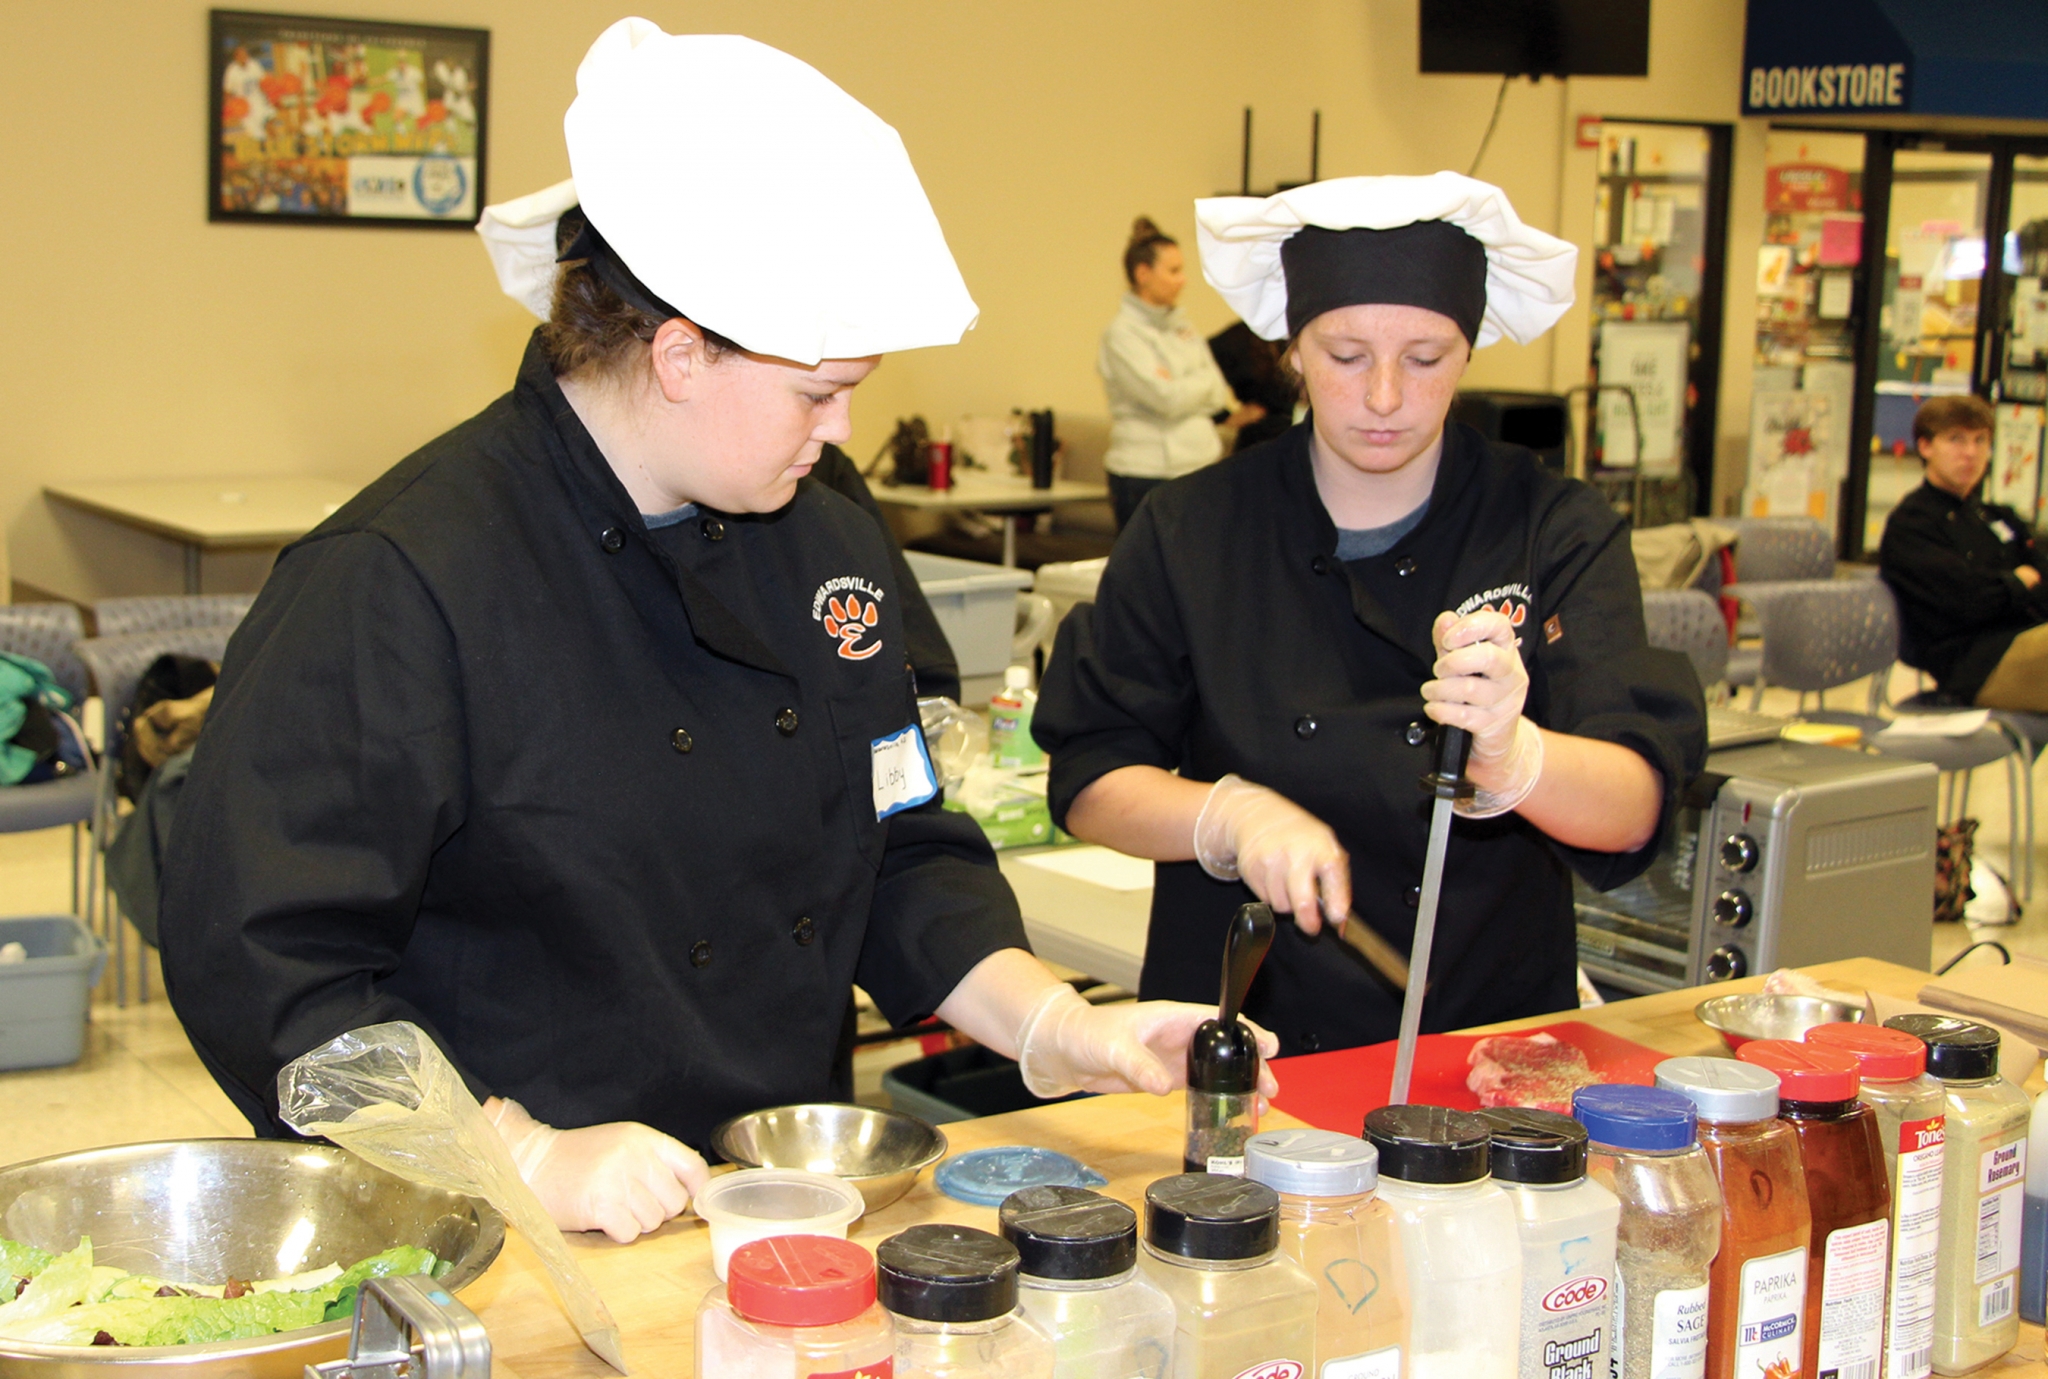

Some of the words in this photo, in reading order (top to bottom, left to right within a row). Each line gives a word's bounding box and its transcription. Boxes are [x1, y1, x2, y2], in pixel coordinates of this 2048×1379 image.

[1750, 62, 1905, 108] BOOKSTORE
[812, 576, 885, 621] EDWARDSVILLE
[1456, 583, 1533, 618] DWARDSVILL
[877, 767, 907, 791] Libby
[1993, 1143, 2018, 1166] Ground
[1988, 1161, 2020, 1184] Rosemary
[1553, 1280, 1598, 1309] code
[1753, 1271, 1797, 1295] PAPRIKA
[1676, 1314, 1705, 1334] SAGE
[1543, 1327, 1602, 1367] Ground
[1550, 1357, 1593, 1379] Black
